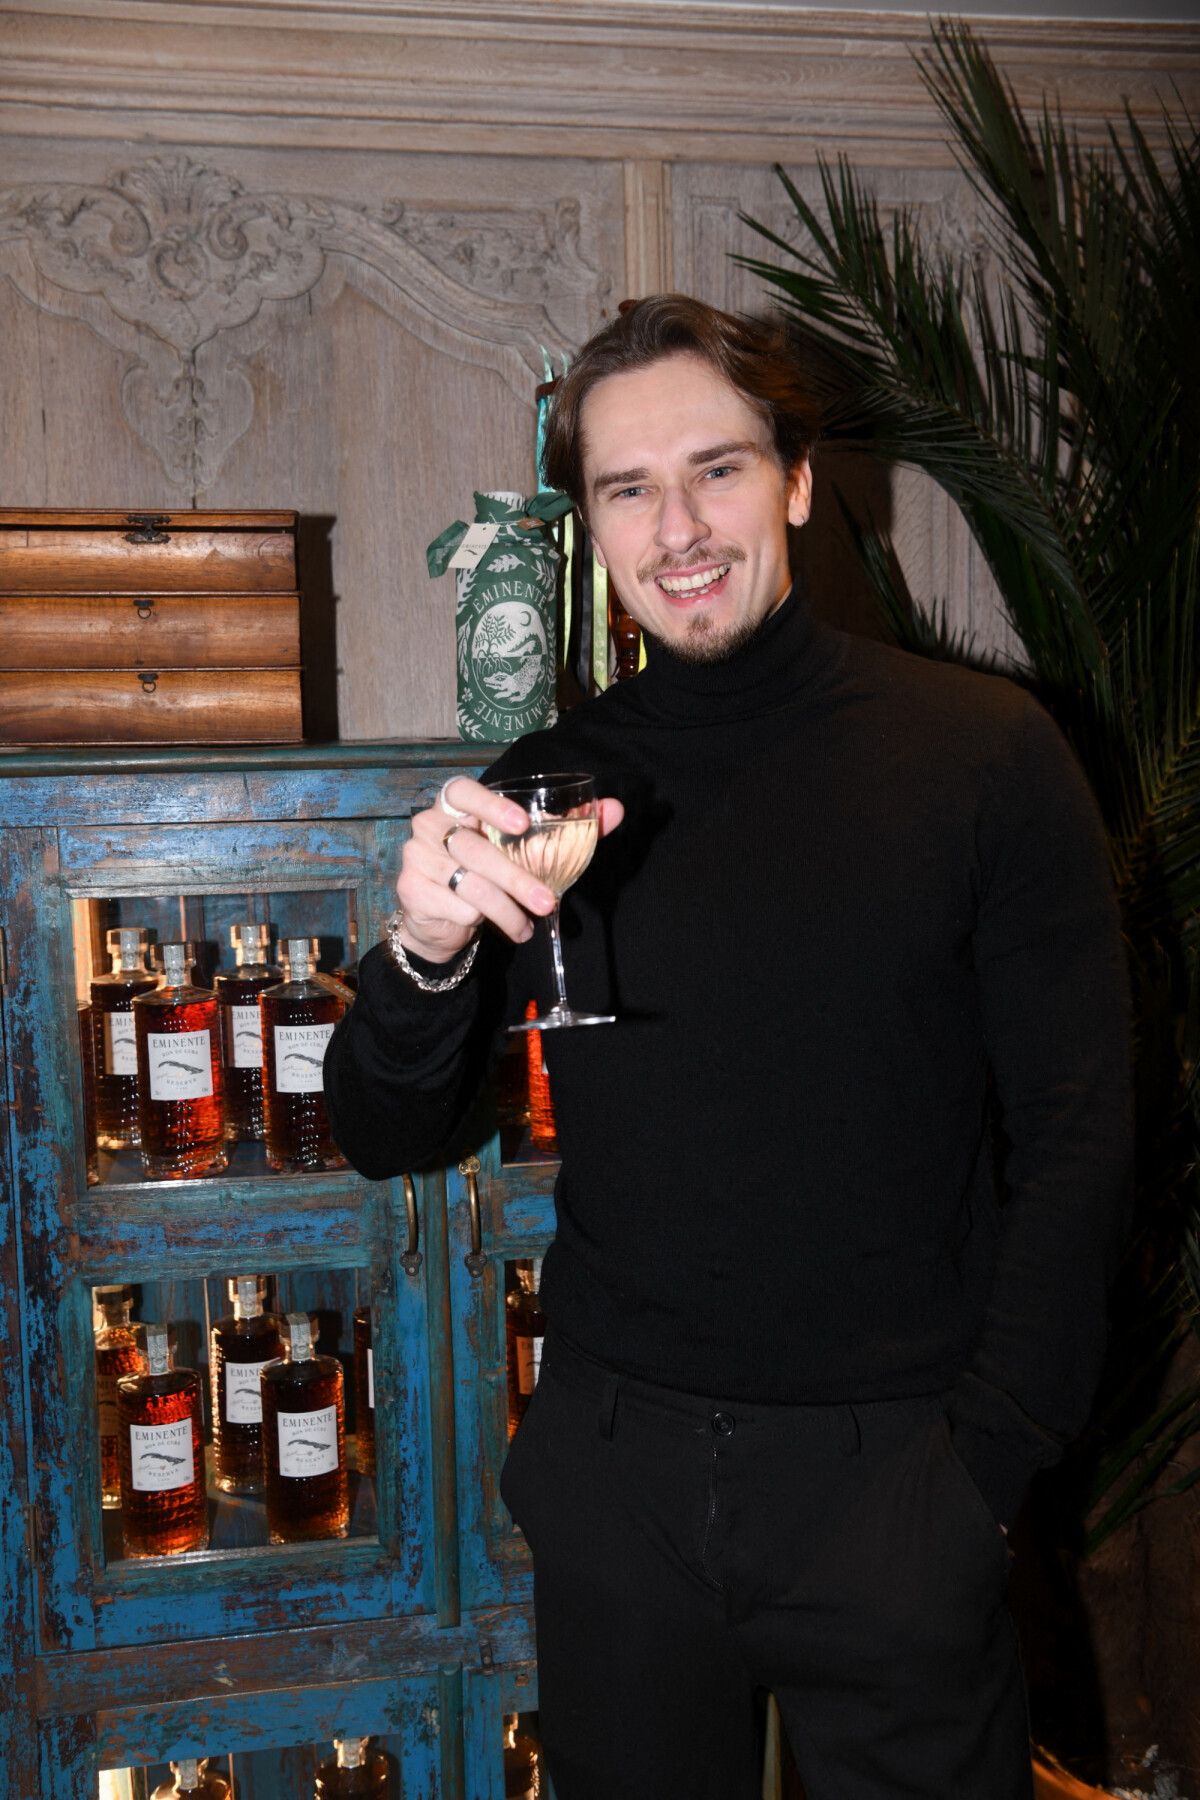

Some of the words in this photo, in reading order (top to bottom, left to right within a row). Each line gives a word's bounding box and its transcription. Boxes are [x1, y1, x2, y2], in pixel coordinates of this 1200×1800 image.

[473, 580, 547, 614] EMINENTE
[153, 1036, 206, 1048] EMINENTE
[279, 1030, 331, 1041] EMINENTE
[282, 1412, 333, 1427] EMINENTE
[135, 1425, 188, 1441] EMINENTE
